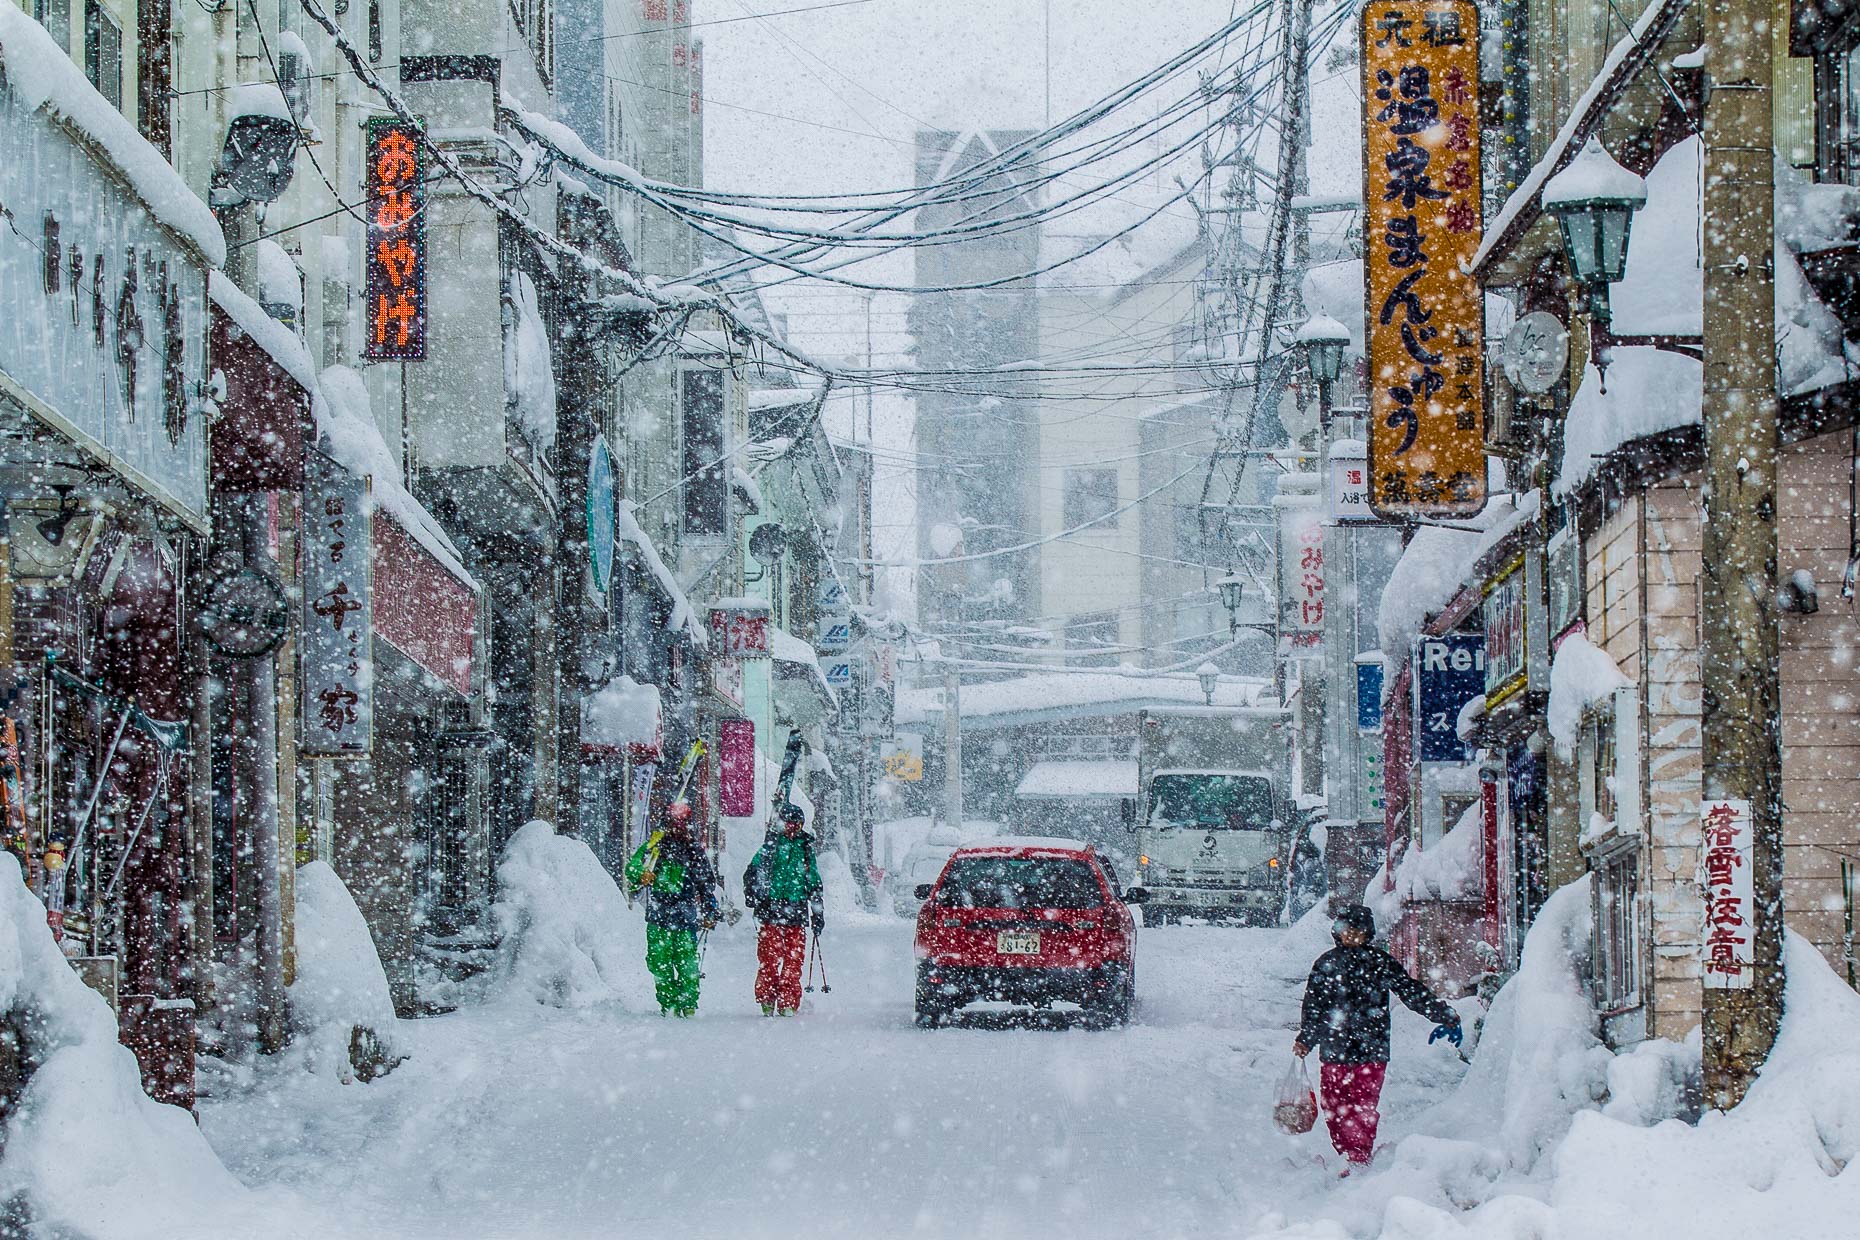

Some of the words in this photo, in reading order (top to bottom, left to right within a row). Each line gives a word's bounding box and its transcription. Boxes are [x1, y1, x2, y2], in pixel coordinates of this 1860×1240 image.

[1375, 11, 1466, 48] 元祖
[1444, 65, 1475, 235] 赤倉名物
[377, 129, 415, 346] おみやげ
[1375, 65, 1452, 457] 温泉まんじゅう
[1347, 470, 1361, 484] 温
[1705, 803, 1746, 976] 落雪注意
